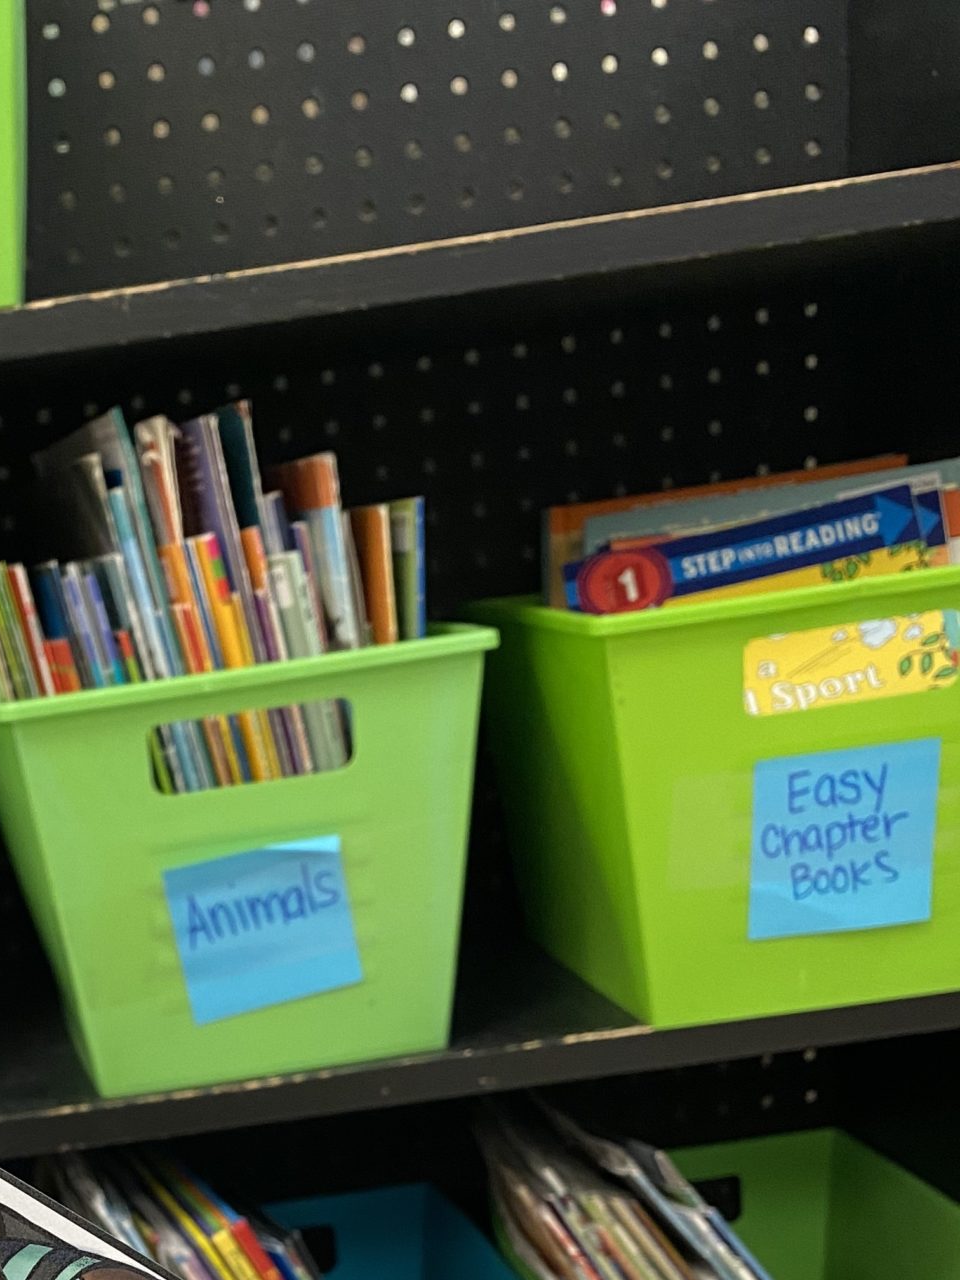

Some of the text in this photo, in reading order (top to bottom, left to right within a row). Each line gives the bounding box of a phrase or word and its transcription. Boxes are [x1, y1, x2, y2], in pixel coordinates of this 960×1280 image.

[681, 547, 736, 580] STEP
[773, 513, 880, 558] READING
[617, 567, 639, 602] 1
[770, 663, 884, 711] Sport
[787, 763, 889, 815] Easy
[760, 810, 911, 861] Chapter
[790, 849, 900, 901] Books
[186, 861, 341, 951] Animals
